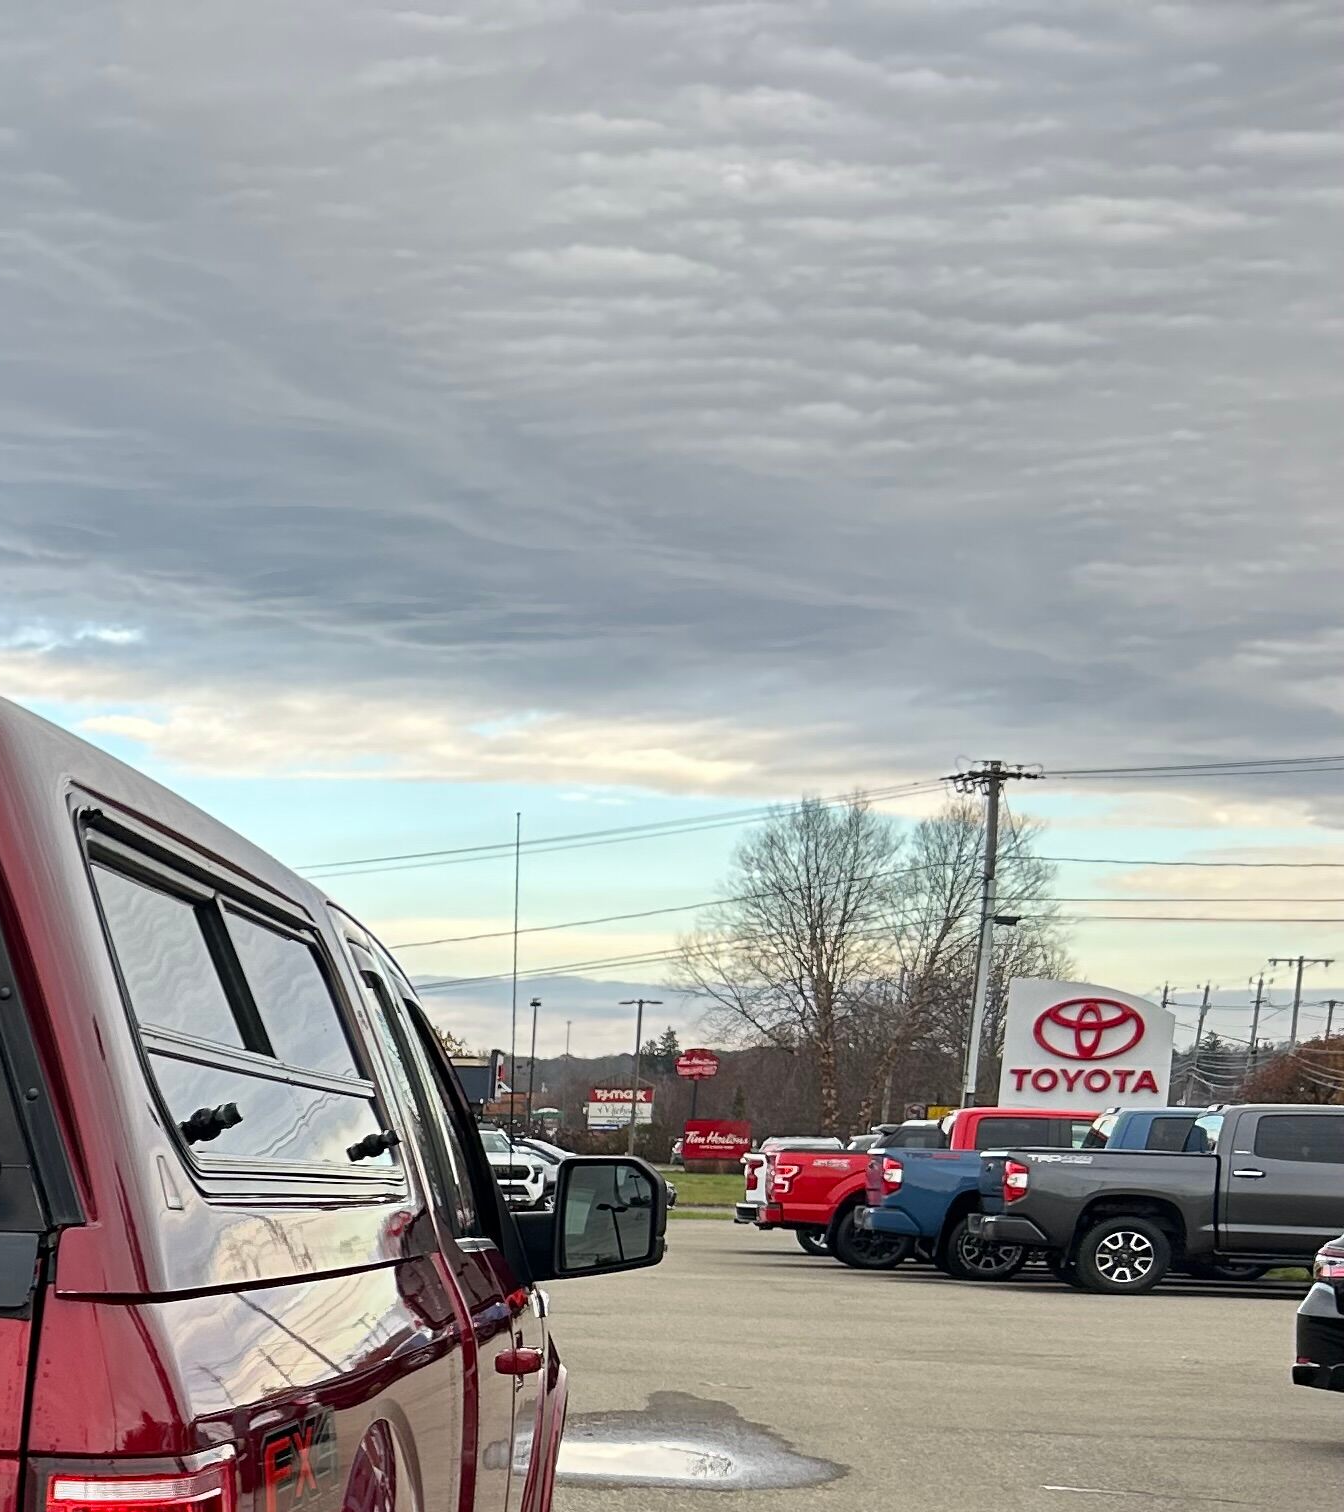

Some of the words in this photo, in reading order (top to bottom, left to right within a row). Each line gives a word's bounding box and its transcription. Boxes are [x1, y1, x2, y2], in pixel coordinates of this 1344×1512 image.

[1010, 1068, 1159, 1094] TOYOTA
[685, 1131, 706, 1145] Tim
[707, 1131, 749, 1145] Hortons
